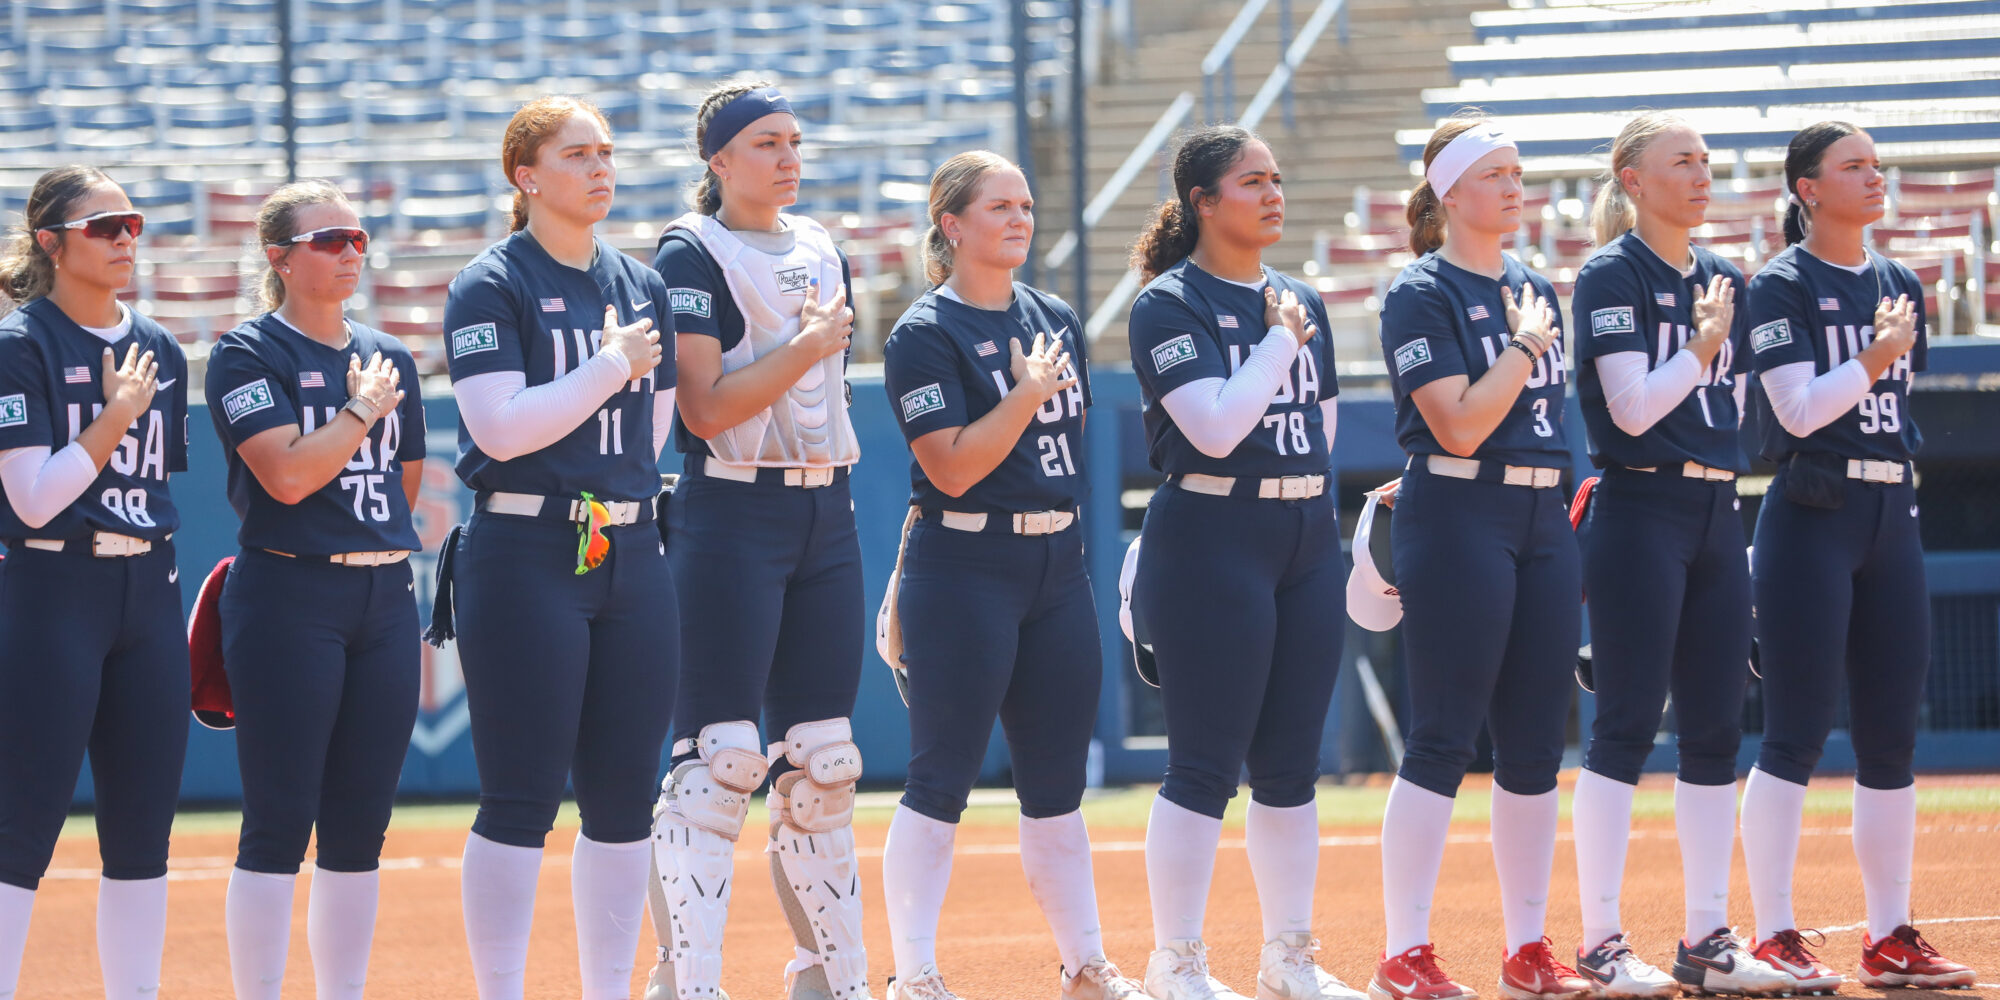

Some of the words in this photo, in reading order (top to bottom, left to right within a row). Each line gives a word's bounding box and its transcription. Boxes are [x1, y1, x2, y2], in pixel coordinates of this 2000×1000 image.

[778, 272, 808, 287] Rawlings
[671, 294, 708, 311] DICK'S
[1594, 313, 1630, 329] DICK'S
[455, 329, 493, 351] DICK'S
[1156, 341, 1192, 366] DICK'S
[227, 387, 268, 415] DICK'S
[904, 391, 939, 414] DICK'S
[1858, 392, 1900, 434] 99
[598, 408, 623, 455] 11
[1532, 398, 1553, 438] 3
[1263, 411, 1311, 455] 78
[1037, 433, 1076, 477] 21
[340, 474, 390, 521] 75
